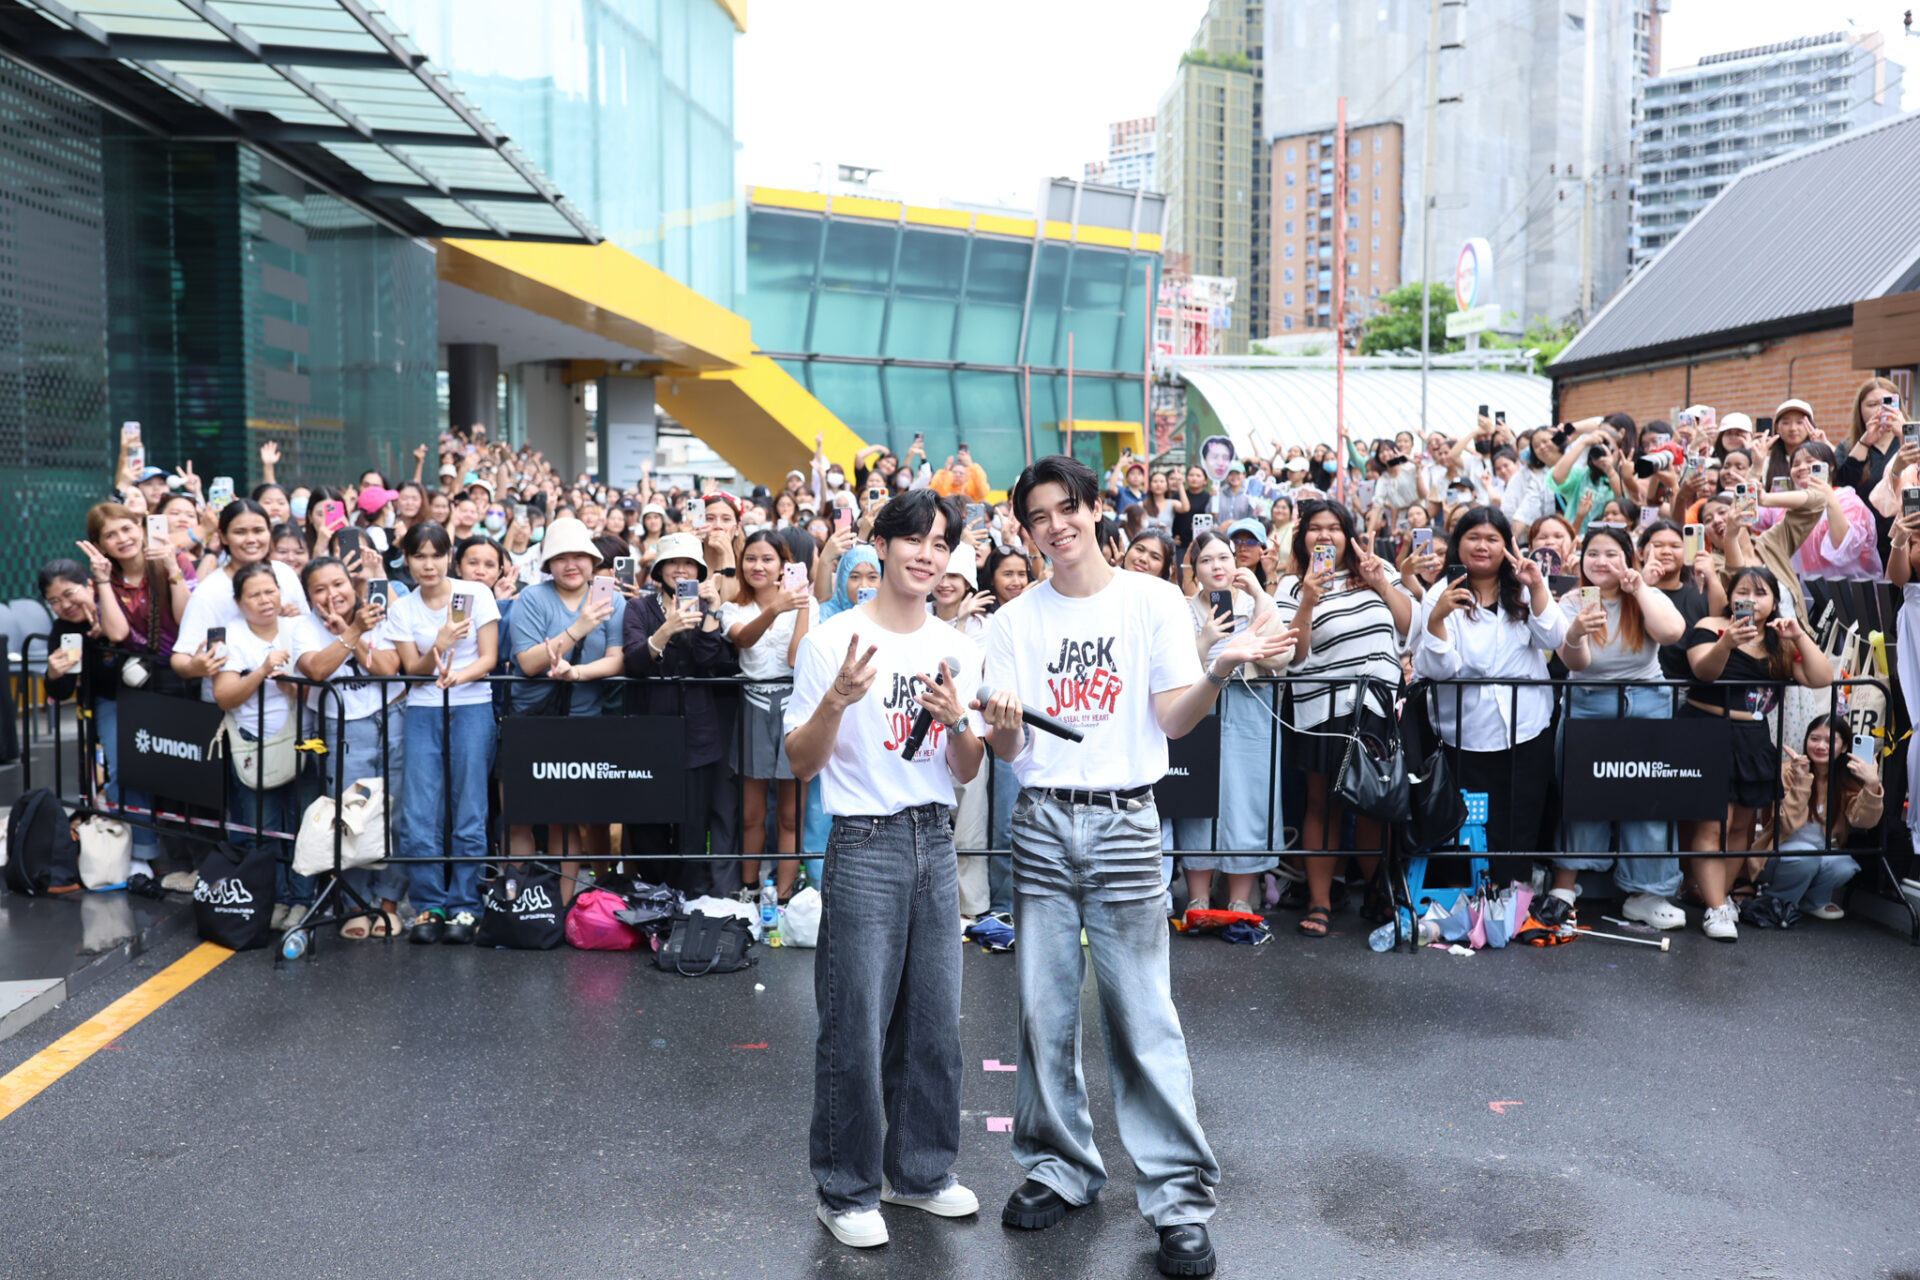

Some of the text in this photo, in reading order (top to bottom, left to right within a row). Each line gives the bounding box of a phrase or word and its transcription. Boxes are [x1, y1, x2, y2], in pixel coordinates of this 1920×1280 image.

[1047, 636, 1118, 674] JACK
[1073, 664, 1088, 685] &
[1046, 667, 1123, 717] JOKER
[883, 712, 945, 751] JOR
[1848, 709, 1878, 737] ER
[532, 762, 596, 779] UNION
[597, 770, 653, 779] EVENT MALL
[1166, 767, 1190, 776] MALL
[1593, 761, 1651, 778] UNION
[1652, 769, 1702, 778] EVENT MALL
